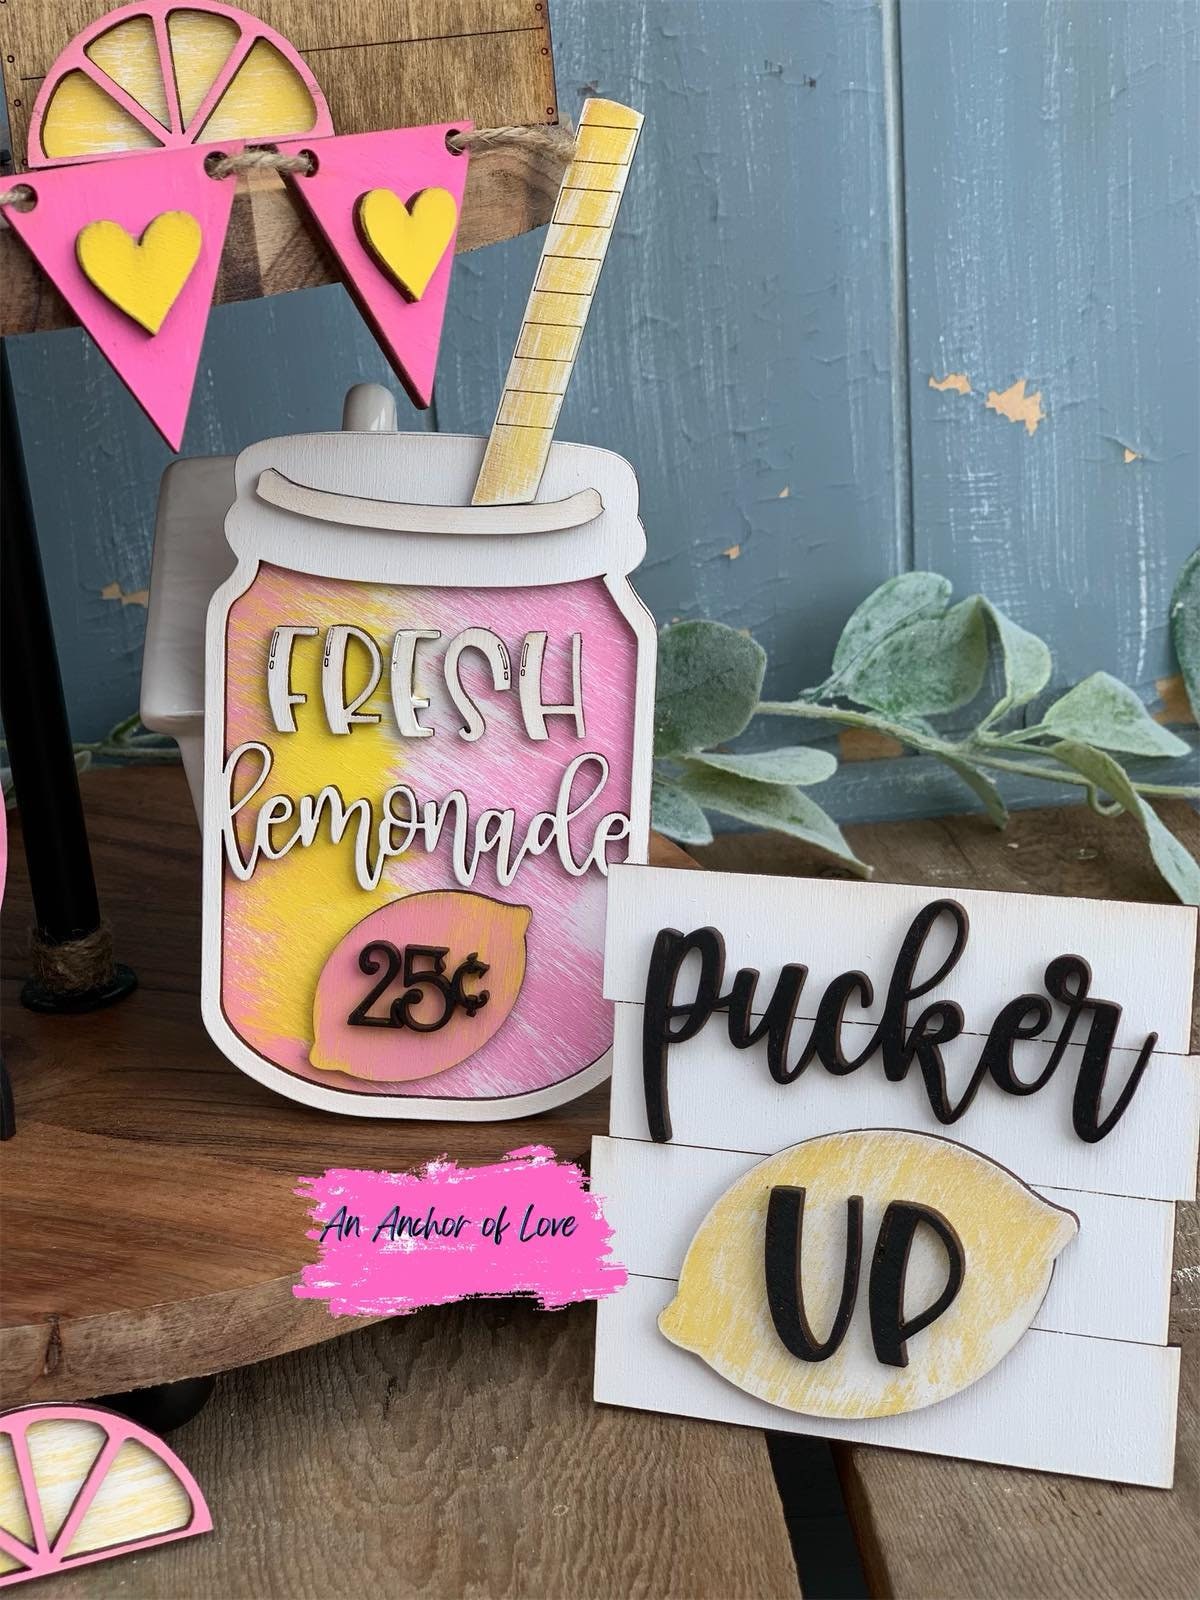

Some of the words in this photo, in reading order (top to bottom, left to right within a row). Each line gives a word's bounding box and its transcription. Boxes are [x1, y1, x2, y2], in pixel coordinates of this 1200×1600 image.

[267, 624, 586, 742] FRESH
[222, 741, 631, 891] lemonade
[347, 940, 490, 1032] 25¢
[764, 1185, 966, 1368] UP
